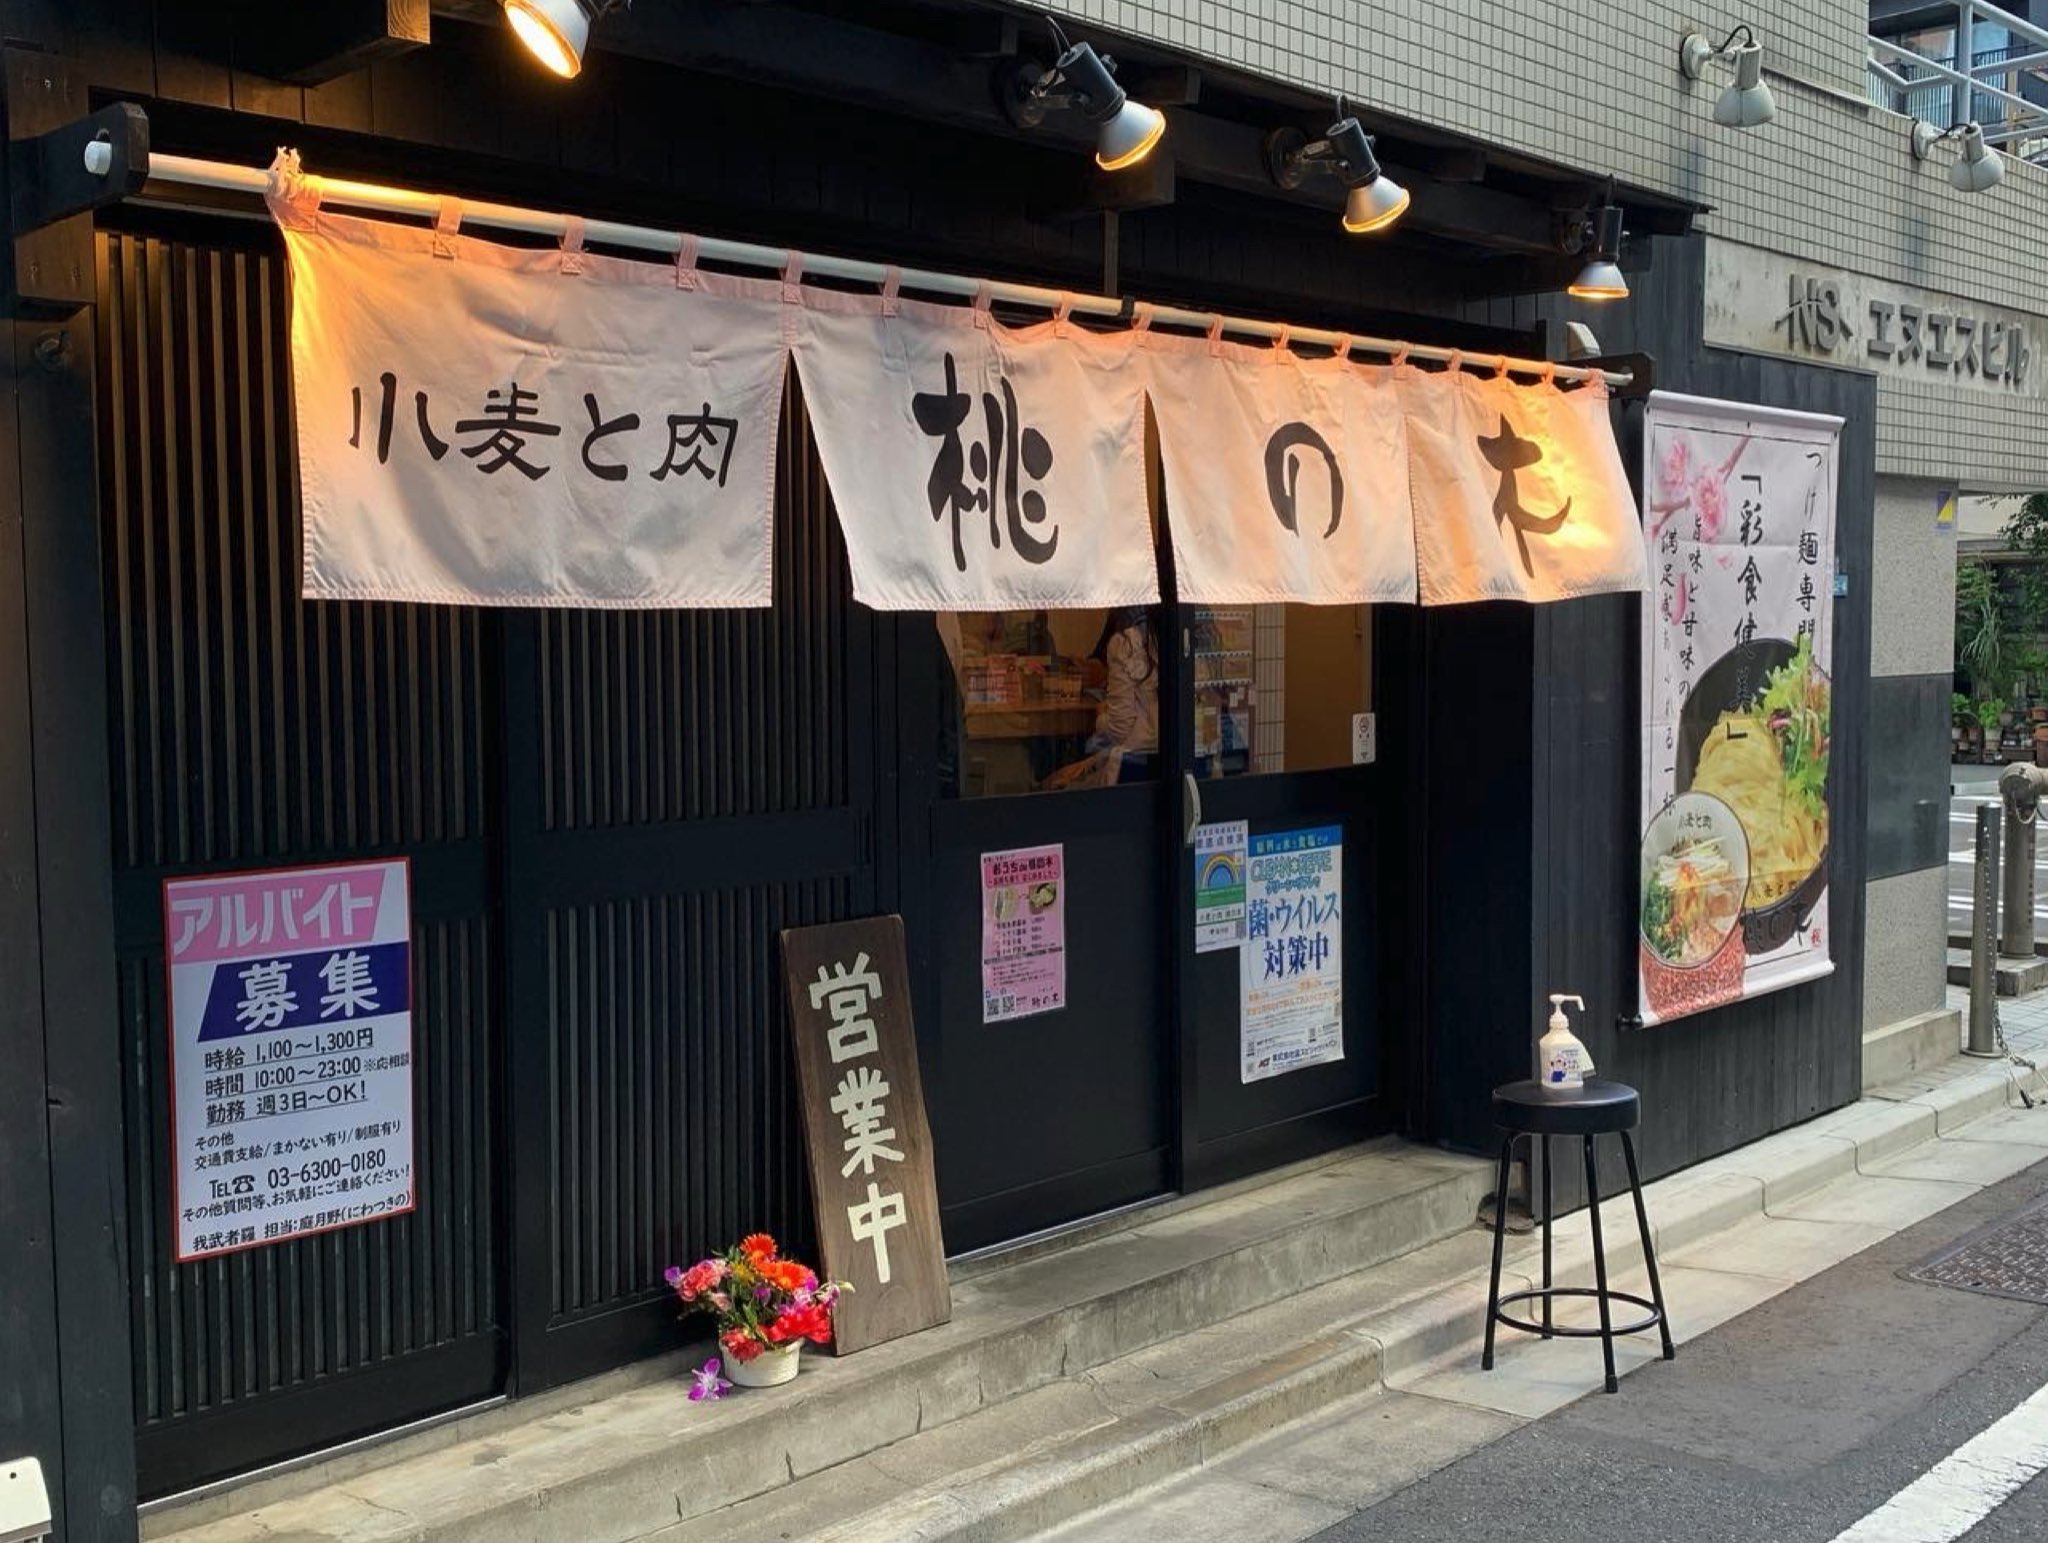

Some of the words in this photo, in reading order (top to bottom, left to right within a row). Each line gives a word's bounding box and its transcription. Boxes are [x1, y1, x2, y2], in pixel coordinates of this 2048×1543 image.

[1867, 300, 2030, 386] エヌエスビル
[349, 372, 739, 487] 小麦と肉
[171, 880, 374, 957] アルバイト
[1248, 892, 1339, 941] 菌・ウイルス
[1264, 931, 1329, 981] 対策中
[235, 950, 381, 1032] 募集
[204, 1046, 246, 1071] 時給
[204, 1072, 244, 1098] 時間
[206, 1100, 246, 1125] 勤務
[808, 951, 908, 1284] 営業中
[194, 1132, 235, 1151] その他
[267, 1148, 386, 1190] 03-6300-0180
